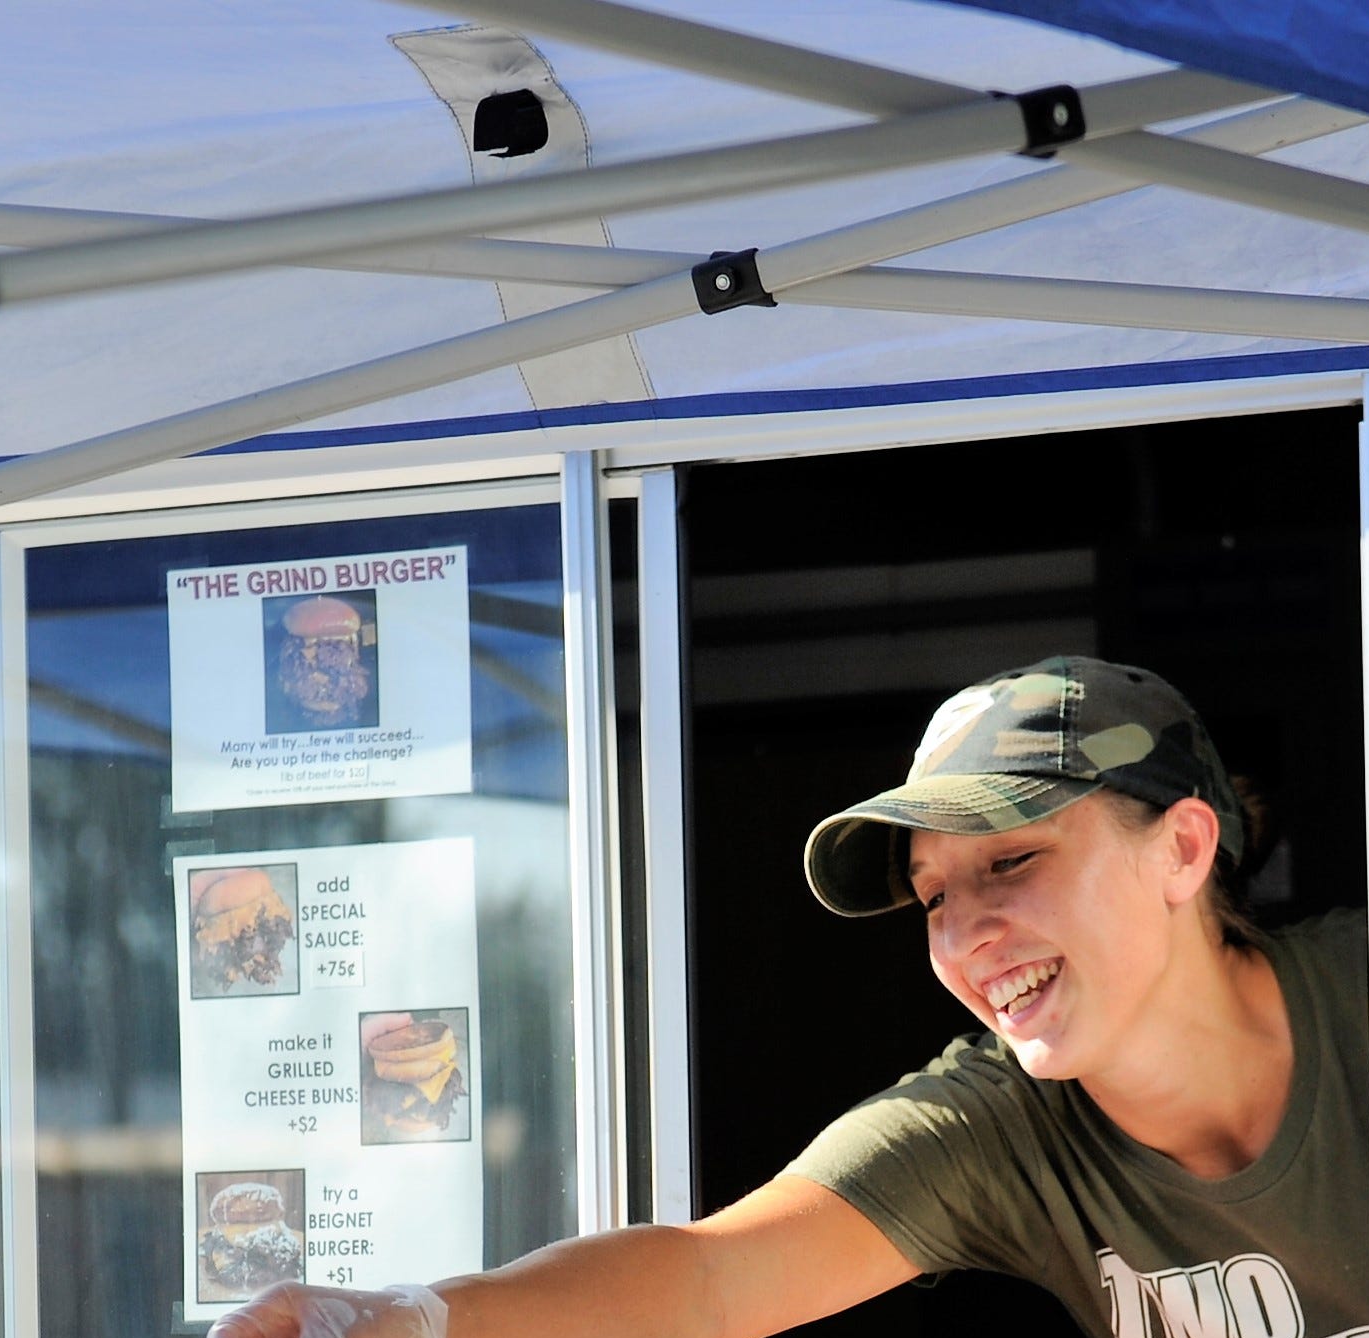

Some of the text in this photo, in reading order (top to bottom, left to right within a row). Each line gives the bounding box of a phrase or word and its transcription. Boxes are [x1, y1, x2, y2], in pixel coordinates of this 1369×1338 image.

[247, 566, 327, 595] GRIND
[220, 740, 255, 753] Many
[259, 738, 279, 751] will
[335, 733, 355, 746] will
[230, 744, 414, 770] Are you up for the challenge?
[316, 875, 351, 894] add
[301, 902, 367, 922] SPECIAL
[304, 930, 365, 949] SAUCE:
[316, 958, 357, 978] +75¢
[268, 1032, 333, 1053] make it
[267, 1061, 335, 1081] GRILLED
[244, 1086, 359, 1108] CHEESE BUNS:
[287, 1115, 319, 1136] +$2
[322, 1185, 359, 1204] try a
[308, 1211, 374, 1230] BEIGNET
[307, 1239, 375, 1258] BURGER:
[326, 1266, 354, 1286] +$1
